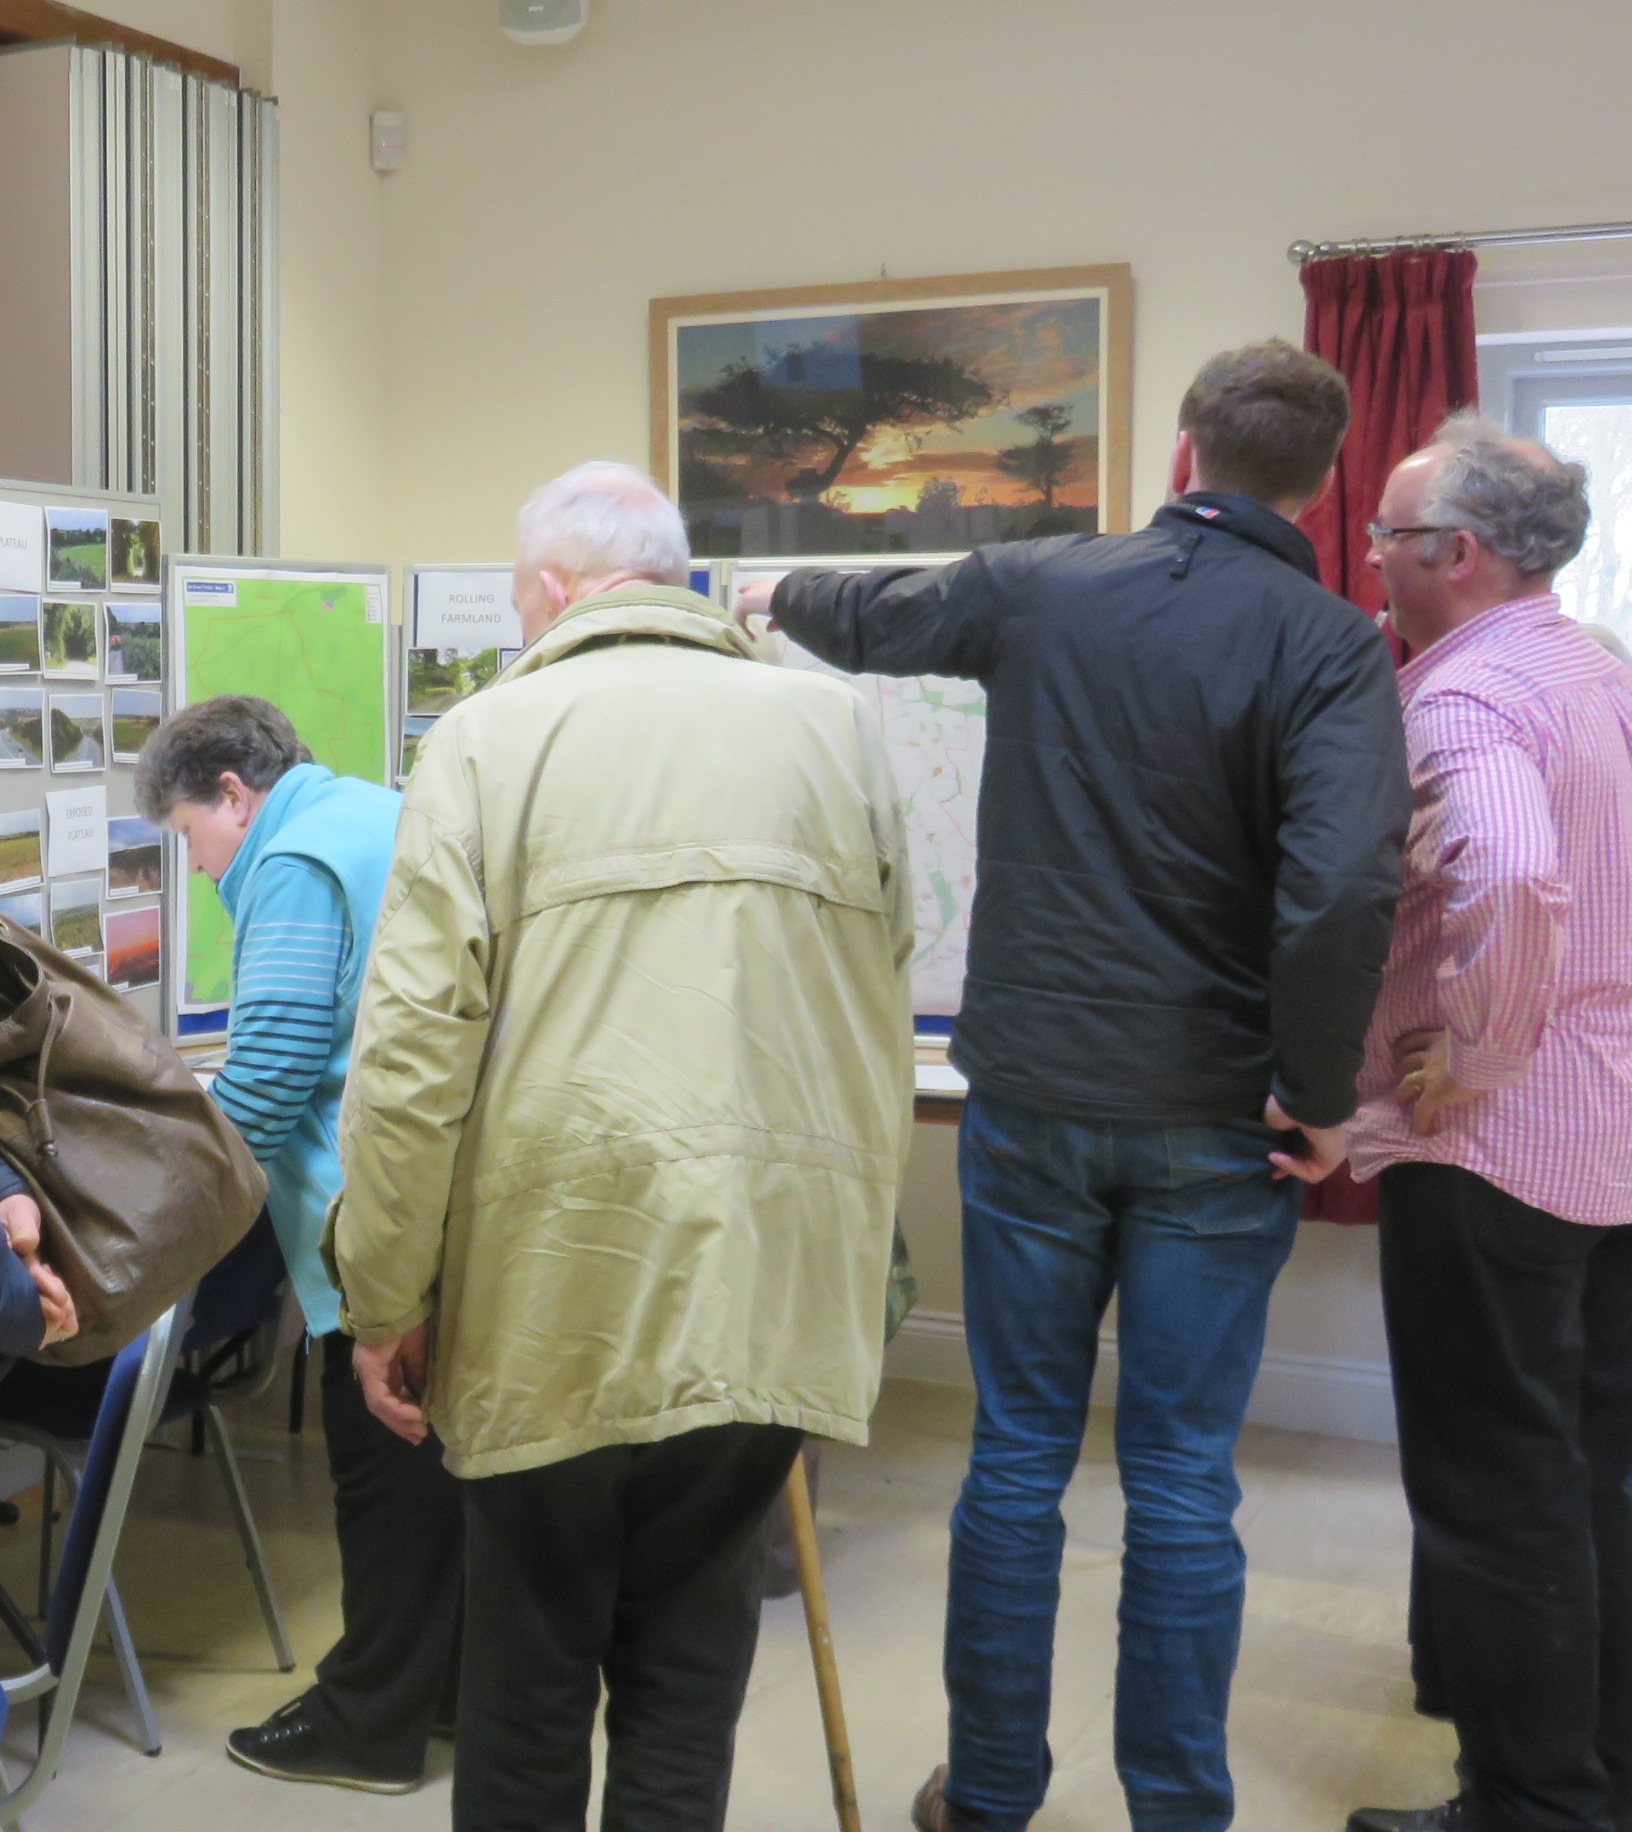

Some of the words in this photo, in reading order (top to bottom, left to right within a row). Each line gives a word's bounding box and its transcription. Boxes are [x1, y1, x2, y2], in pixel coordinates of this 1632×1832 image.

[448, 594, 494, 604] ROLLING
[441, 613, 501, 624] FARMLAND
[66, 806, 93, 820] EXPOSED
[67, 829, 94, 842] PLATEAU
